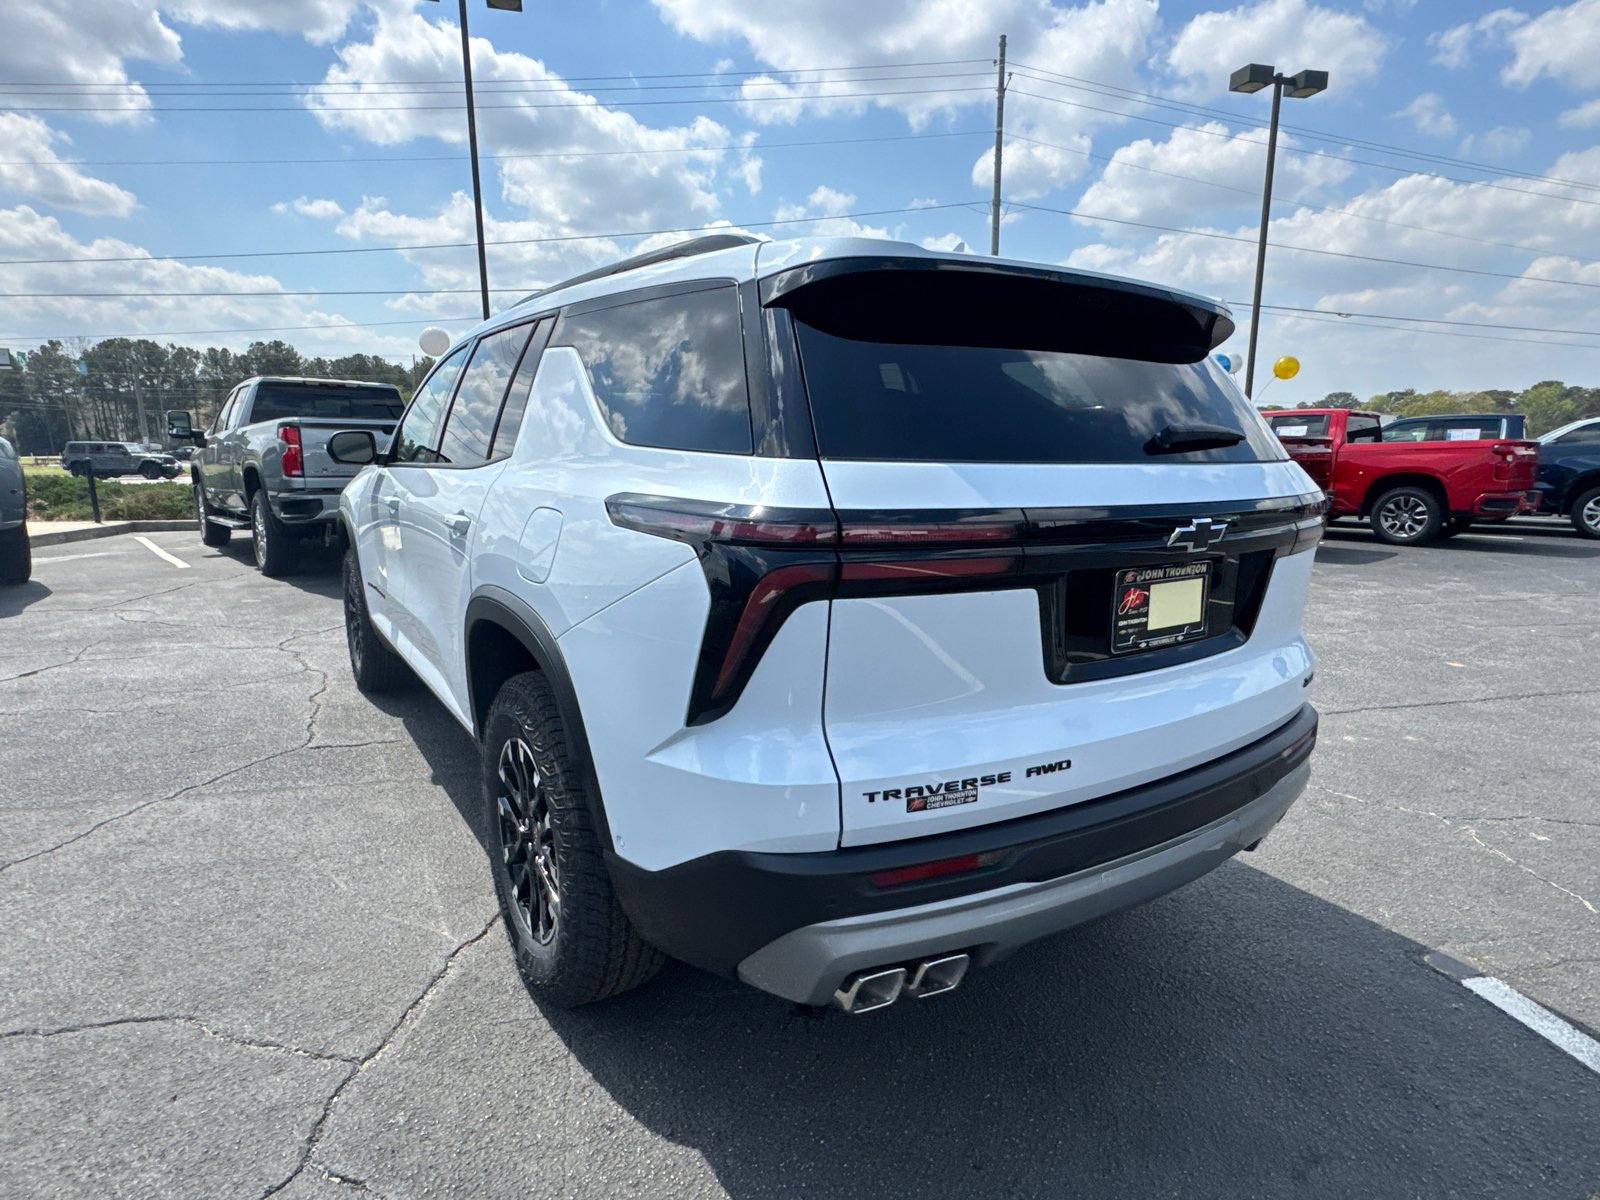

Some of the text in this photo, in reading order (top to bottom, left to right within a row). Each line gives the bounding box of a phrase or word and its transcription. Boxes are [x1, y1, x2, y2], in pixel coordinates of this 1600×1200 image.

[1140, 567, 1165, 580] JOHN
[1166, 563, 1207, 578] THORNTON
[862, 759, 1072, 803] TRAVERSE AWD
[926, 798, 965, 809] CHEVROLET
[927, 789, 977, 803] JOHN THORNTON
